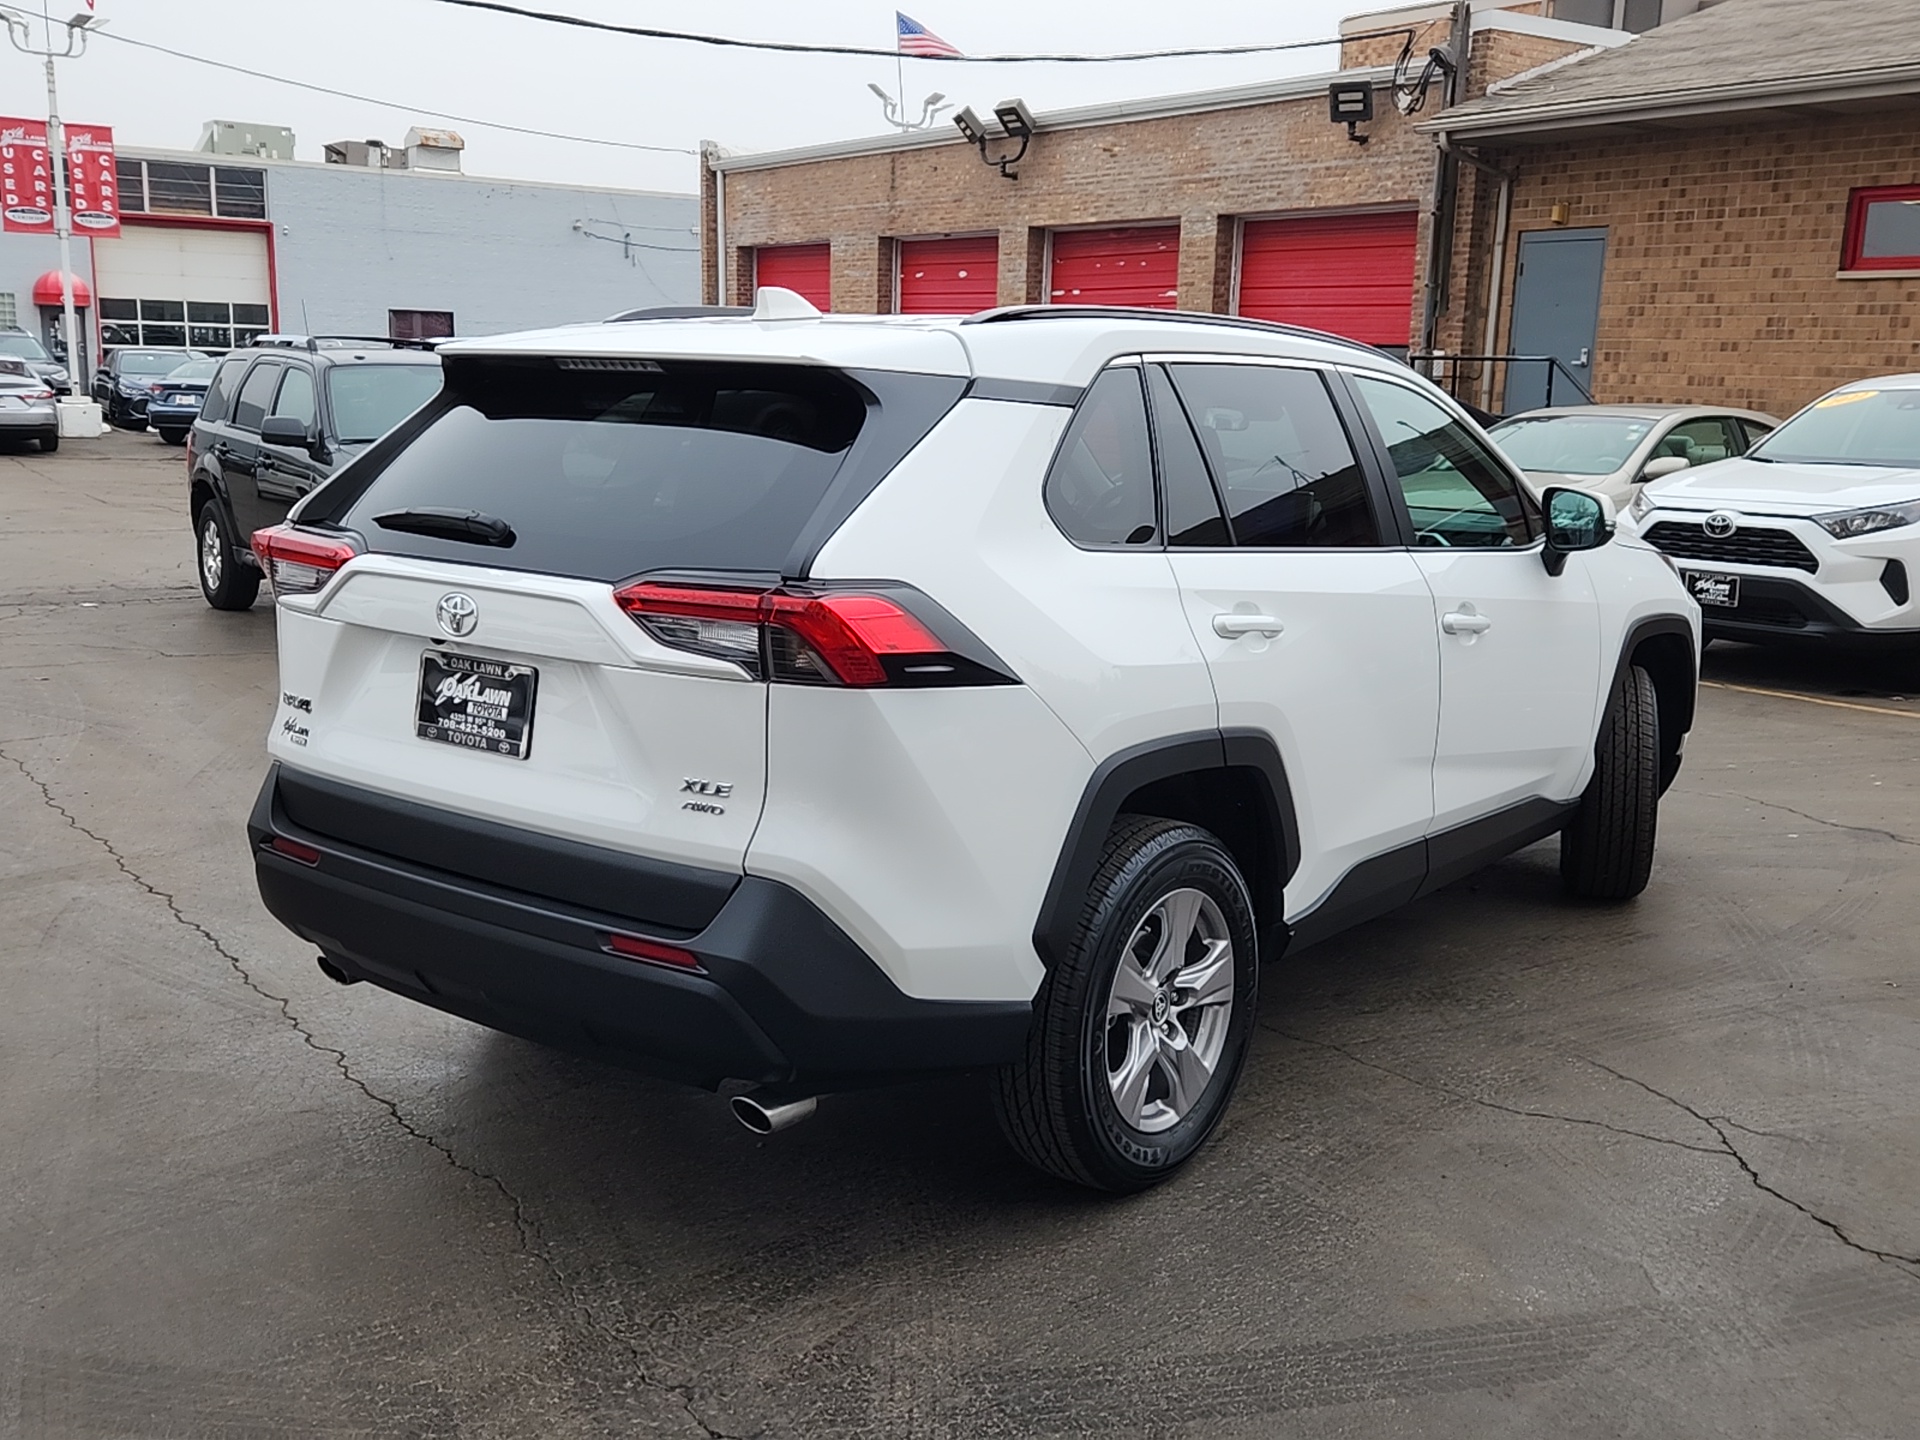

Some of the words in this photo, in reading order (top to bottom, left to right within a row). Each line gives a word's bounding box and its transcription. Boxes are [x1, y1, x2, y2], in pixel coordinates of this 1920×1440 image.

[2, 147, 19, 205] USED
[32, 149, 47, 207] CARS
[71, 153, 87, 209] USED
[99, 155, 113, 212] CARS
[450, 657, 471, 670] OAK
[474, 662, 502, 675] LAWN
[471, 703, 502, 718] TOYOTA
[438, 718, 506, 738] 708-423-5200
[448, 731, 487, 749] TOYOTA
[679, 777, 733, 799] XLE
[681, 800, 725, 816] AWD
